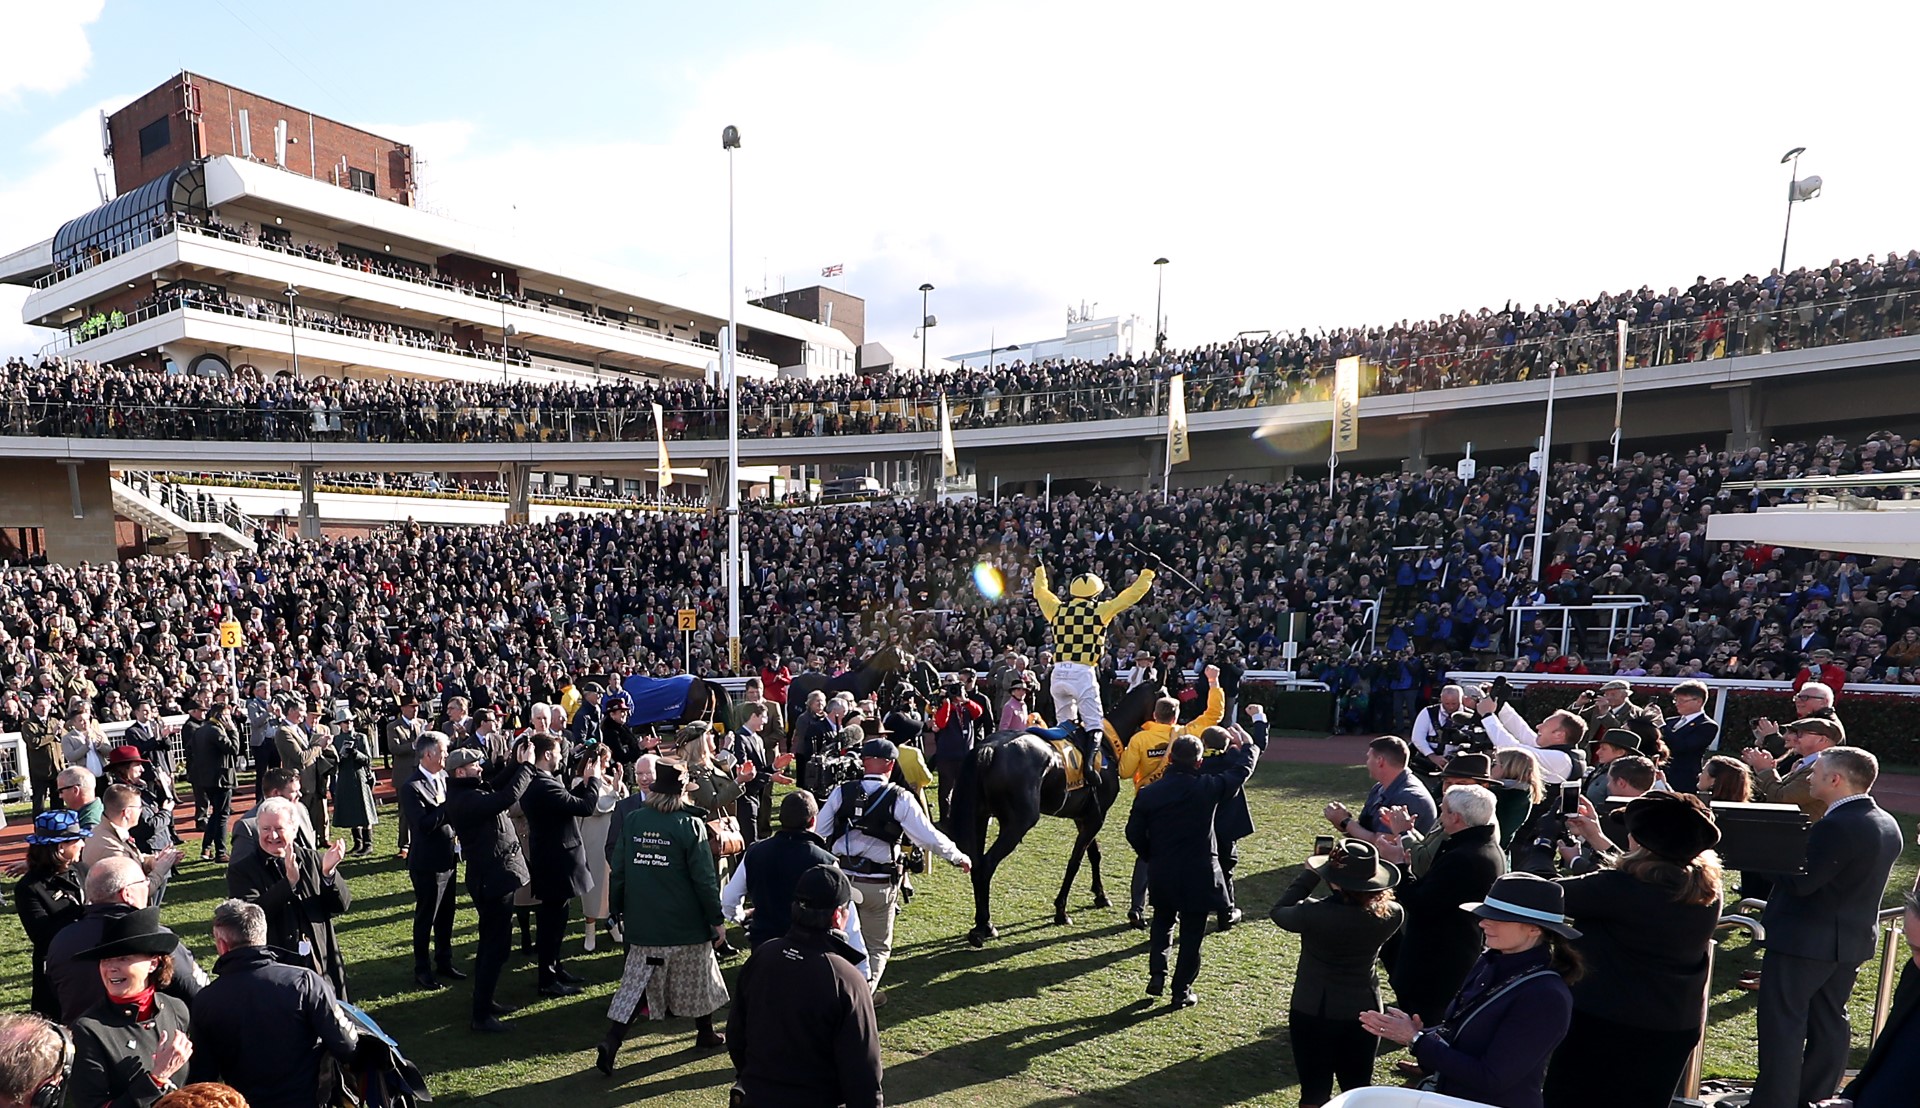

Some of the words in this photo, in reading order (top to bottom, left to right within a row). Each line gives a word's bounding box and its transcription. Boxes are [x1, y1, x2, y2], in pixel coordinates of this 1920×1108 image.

[683, 617, 690, 629] 2
[227, 631, 236, 645] 3
[654, 853, 667, 861] Ring
